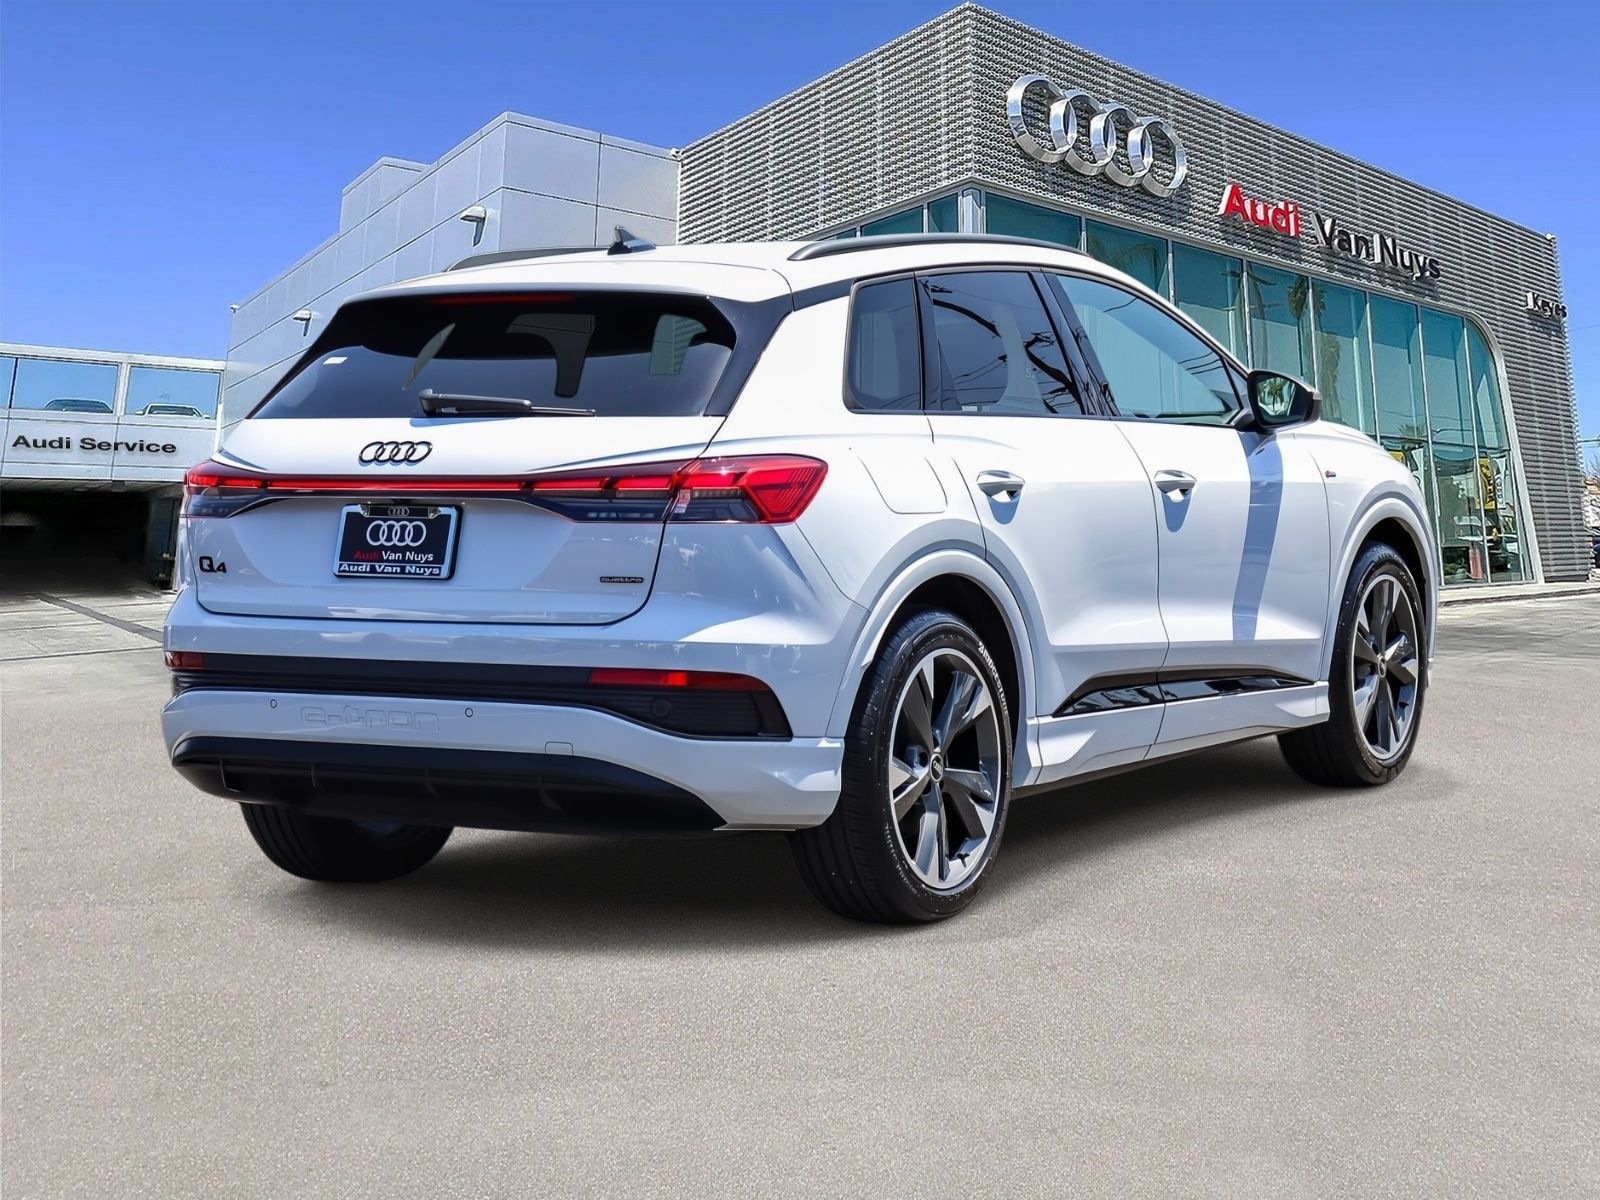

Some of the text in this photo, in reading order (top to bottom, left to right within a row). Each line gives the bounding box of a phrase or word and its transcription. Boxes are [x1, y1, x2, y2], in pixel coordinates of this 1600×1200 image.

[1218, 183, 1442, 281] Audi Van Nuys
[12, 434, 177, 453] Audi Service
[199, 556, 227, 574] Q4
[354, 550, 434, 563] Audi Van Nuys
[339, 563, 440, 575] Audi Van Nuys
[301, 705, 440, 734] e-tron
